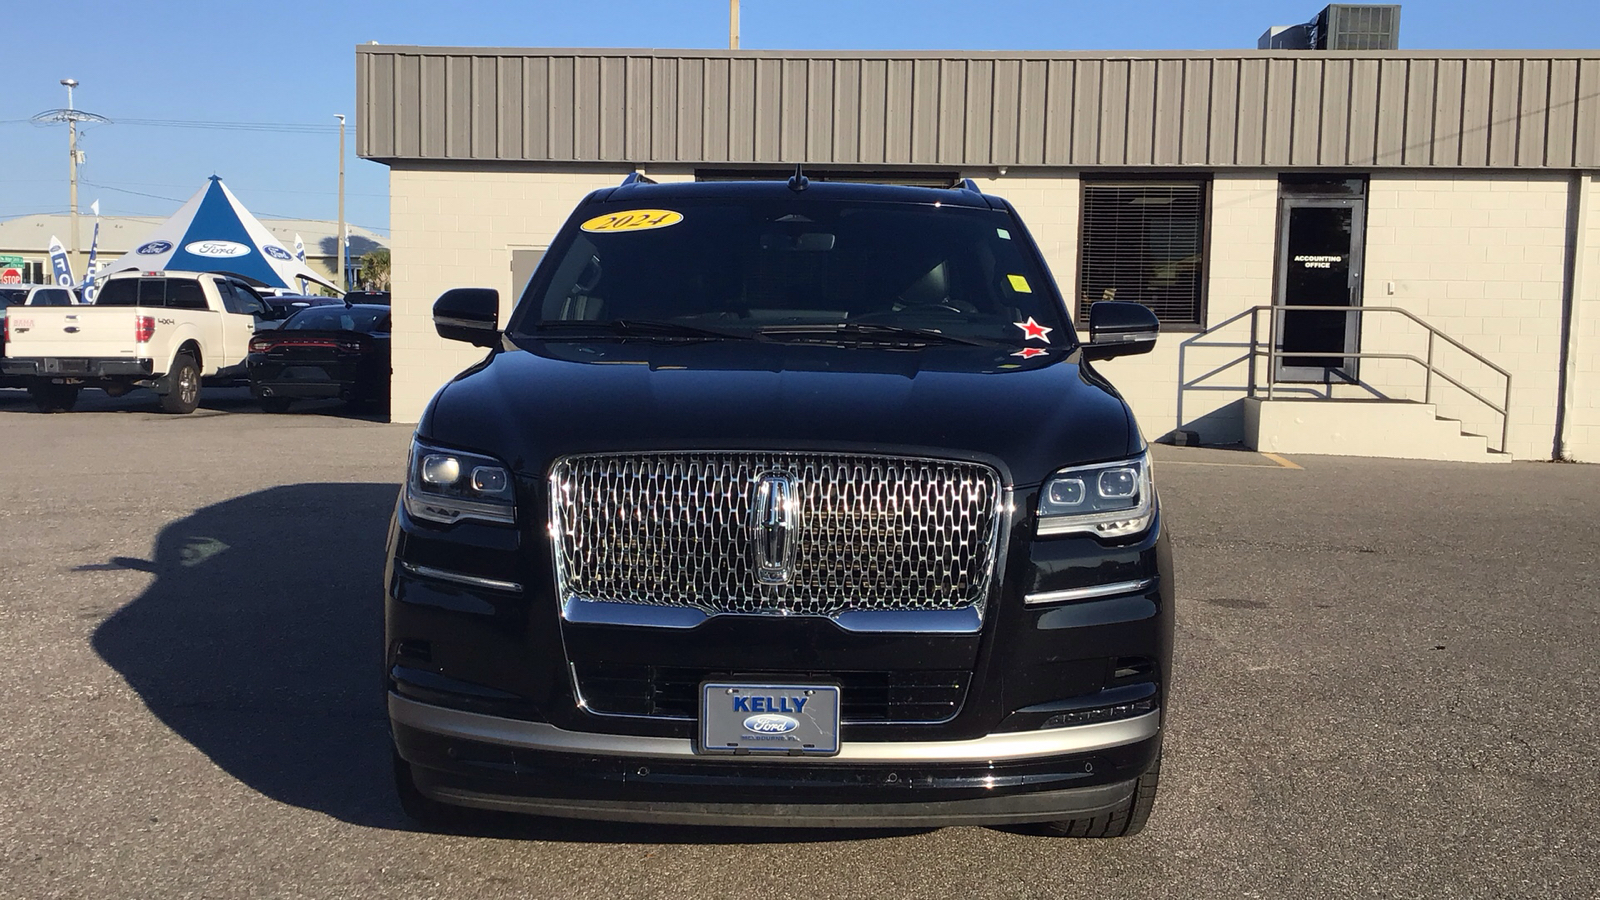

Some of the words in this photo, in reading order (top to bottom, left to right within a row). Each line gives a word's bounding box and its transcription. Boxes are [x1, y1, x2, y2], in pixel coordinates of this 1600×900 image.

[594, 213, 671, 230] 2024
[141, 242, 168, 254] Ford
[199, 243, 236, 255] Ford
[267, 246, 289, 259] Ford
[3, 275, 20, 284] STOP
[733, 696, 808, 713] KELLY
[754, 718, 787, 732] Ford
